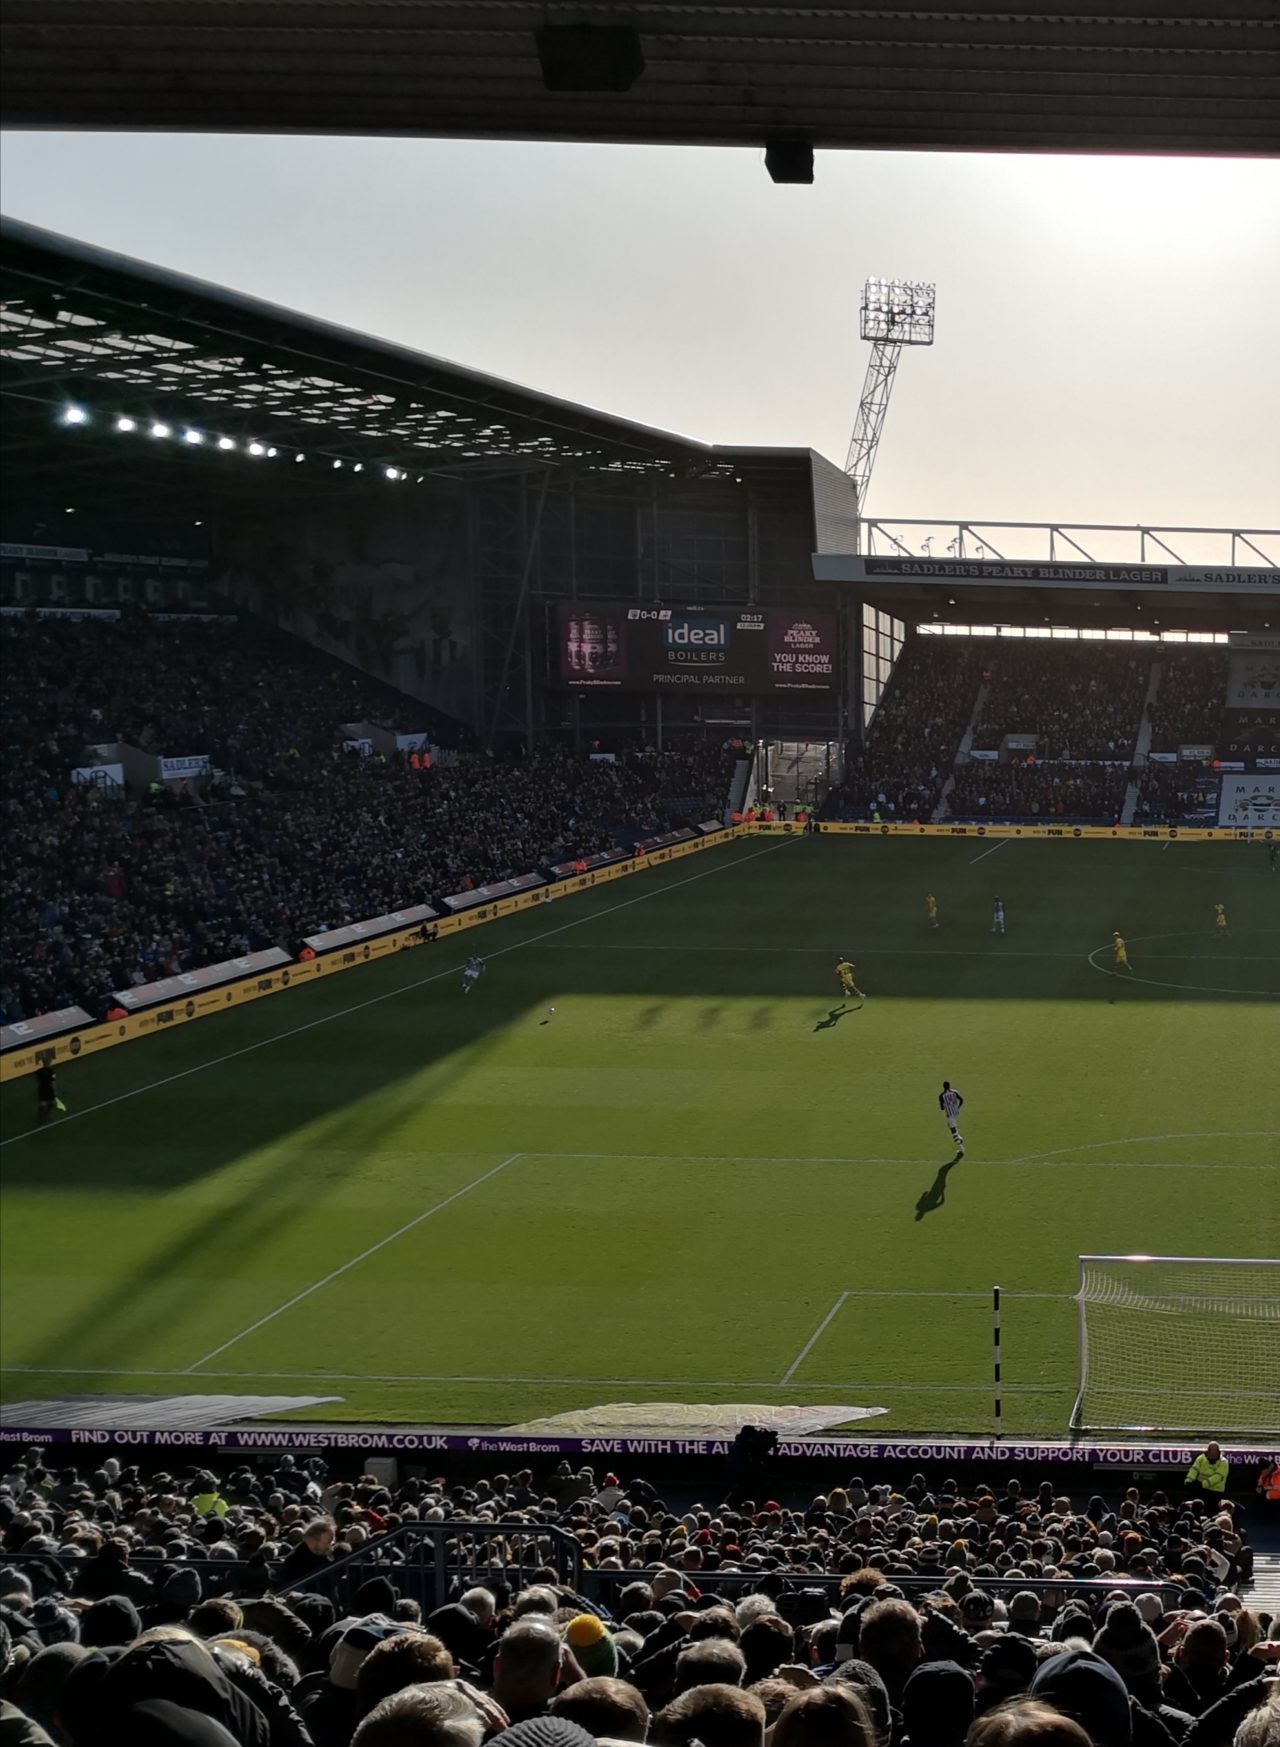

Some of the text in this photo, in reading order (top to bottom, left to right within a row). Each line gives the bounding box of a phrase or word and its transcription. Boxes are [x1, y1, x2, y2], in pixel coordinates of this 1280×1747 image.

[901, 563, 1162, 582] SADLER'S PEAKY BLINDER LAGER
[1204, 573, 1280, 585] SADLER'S
[641, 610, 658, 620] 0-0
[668, 622, 725, 645] ideal
[787, 629, 818, 637] PEAKY
[668, 651, 726, 661] BOILERS
[774, 653, 830, 663] YOU KNOW
[771, 662, 793, 672] THE
[653, 674, 745, 684] PRINCIPAL PARTNER
[22, 1432, 53, 1443] Brom
[71, 1430, 109, 1444] FIND
[114, 1430, 149, 1444] OUT
[155, 1431, 203, 1445] MORE
[208, 1432, 229, 1445] AT
[237, 1433, 448, 1450] WWW.WESTBROM.CO.UK
[499, 1442, 529, 1452] West
[529, 1442, 560, 1453] Brom
[581, 1439, 623, 1453] SAVE
[627, 1440, 671, 1453] WITH
[676, 1441, 715, 1454] THE
[778, 1443, 879, 1458] ADVANTAGE
[883, 1445, 967, 1459] ACCOUNT
[971, 1447, 1009, 1460] AND
[1014, 1447, 1091, 1462] SUPPORT
[1096, 1449, 1144, 1463] YOUR
[1149, 1450, 1192, 1464] CLUB
